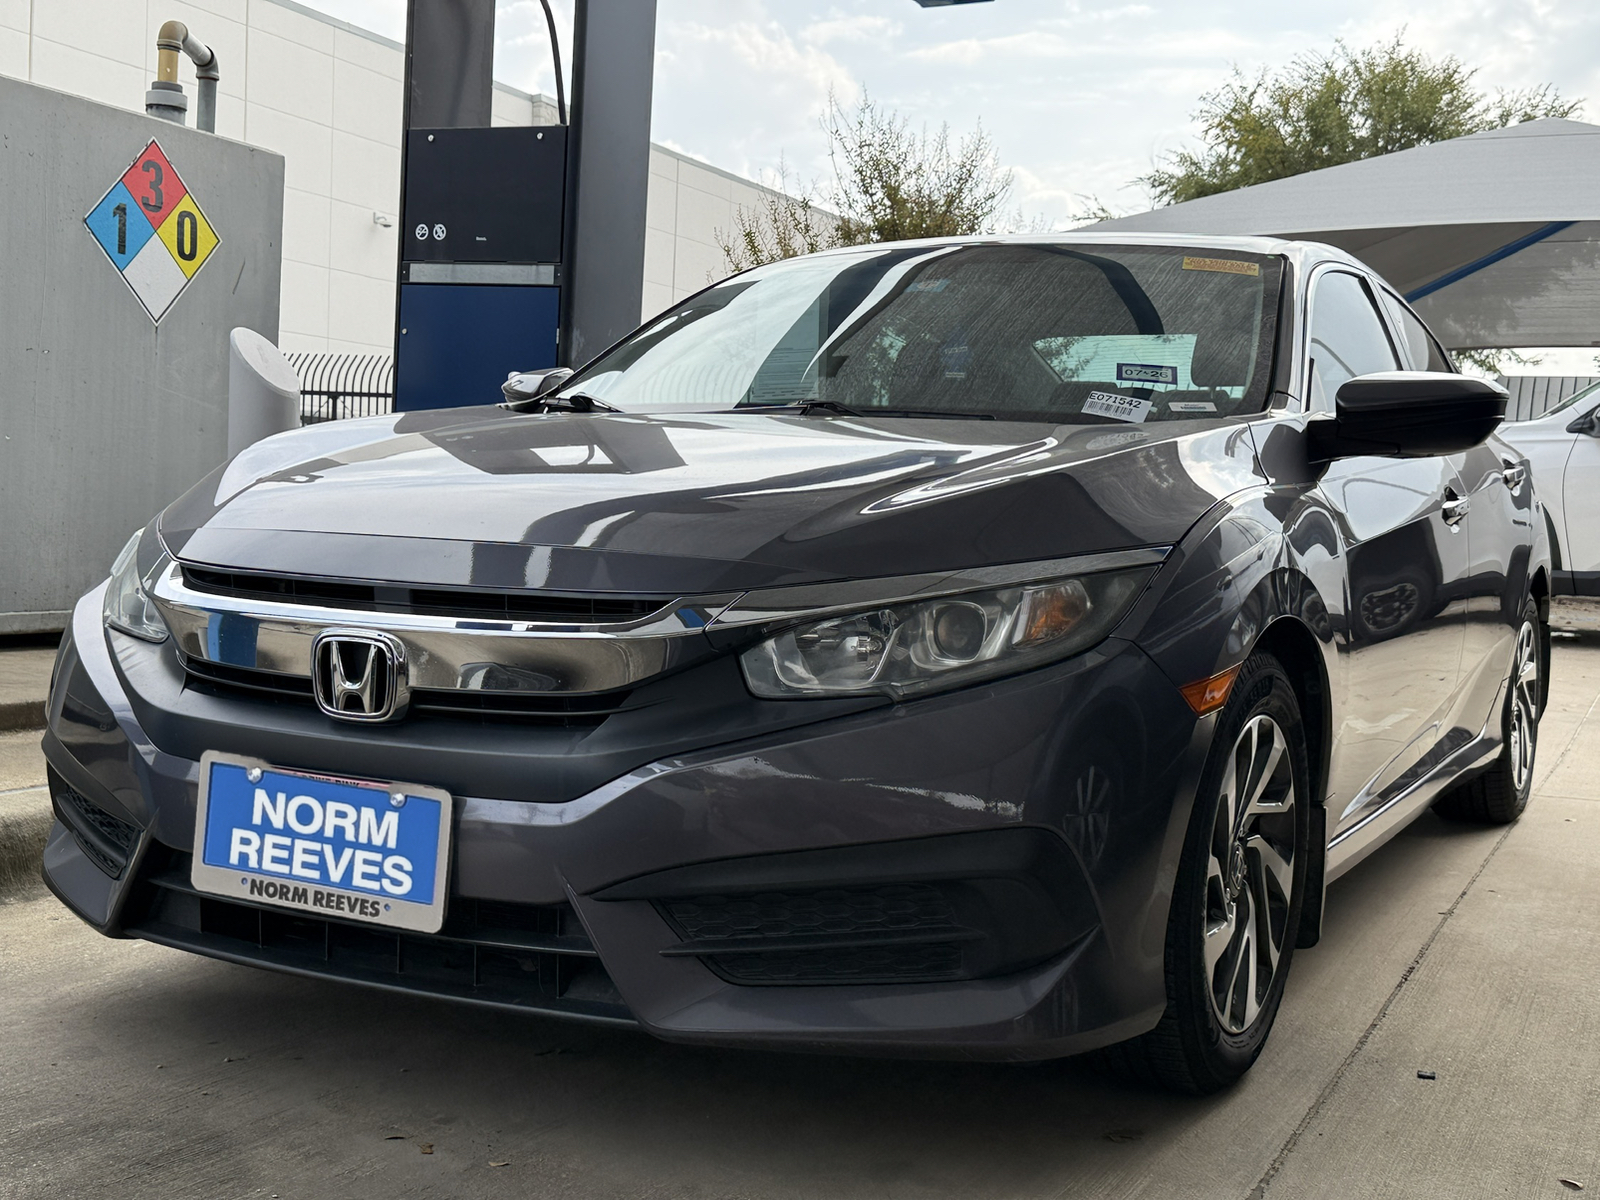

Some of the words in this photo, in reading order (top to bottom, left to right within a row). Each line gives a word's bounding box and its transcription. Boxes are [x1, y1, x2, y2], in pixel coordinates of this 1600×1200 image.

[141, 160, 163, 212] 3
[112, 203, 127, 255] 1
[176, 210, 197, 261] 0
[1089, 392, 1142, 409] E071542
[252, 788, 399, 849] NORM
[229, 827, 413, 895] REEVES
[250, 879, 309, 906] NORM
[313, 890, 380, 917] REEVES
